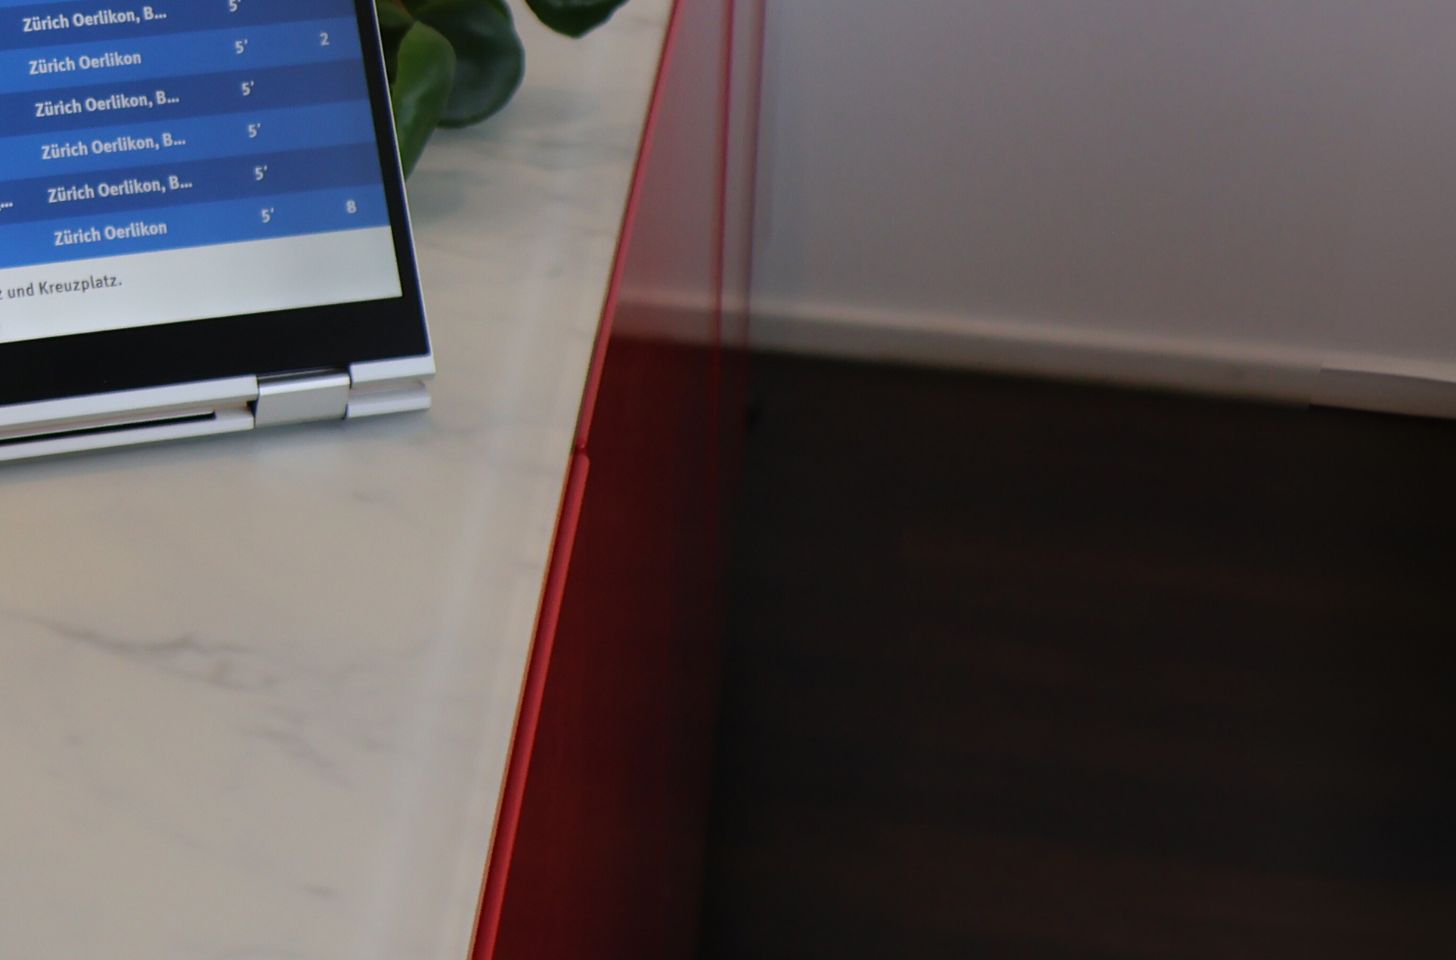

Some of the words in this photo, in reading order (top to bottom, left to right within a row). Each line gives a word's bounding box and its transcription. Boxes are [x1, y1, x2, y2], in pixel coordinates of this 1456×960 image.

[23, 13, 70, 33] Zürich
[73, 10, 140, 26] Oerlikon,
[319, 32, 330, 47] 2
[29, 56, 78, 75] Zürich
[79, 51, 142, 71] Oerlikon
[36, 98, 82, 118] Zürich
[85, 94, 153, 111] Oerlikon,
[42, 140, 89, 160] Zürich
[92, 137, 159, 153] Oerlikon,
[48, 183, 95, 203] Zürich
[98, 179, 165, 197] Oerlikon,
[54, 227, 102, 246] Zürich
[104, 221, 168, 241] Oerlikon
[8, 283, 34, 298] und
[39, 275, 122, 295] Kreuzplatz.
